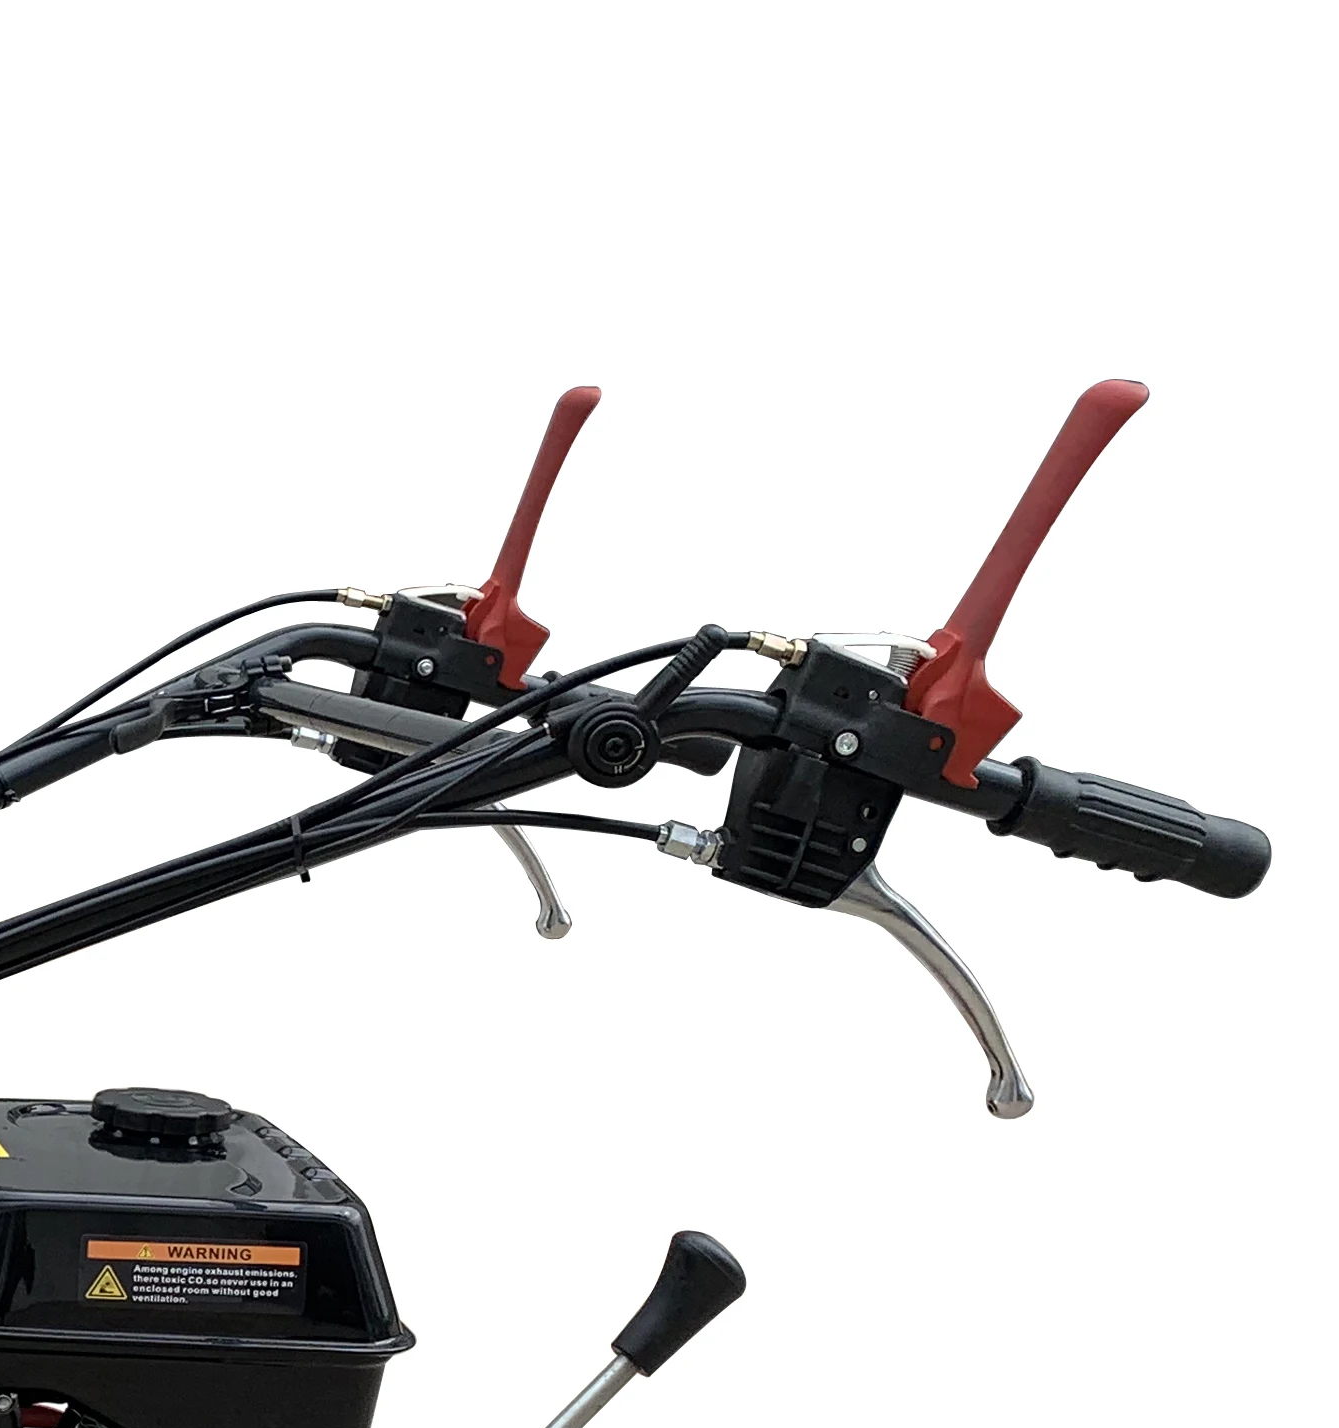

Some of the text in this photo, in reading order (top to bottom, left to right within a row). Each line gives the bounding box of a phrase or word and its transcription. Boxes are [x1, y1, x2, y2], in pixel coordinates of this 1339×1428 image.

[167, 1246, 252, 1261] WARNING
[133, 1264, 168, 1276] Among
[170, 1267, 203, 1277] engine
[205, 1267, 244, 1277] exhaust
[133, 1275, 159, 1283] there
[161, 1276, 186, 1284] toxic
[269, 1279, 279, 1288] in
[133, 1284, 279, 1298] enclosed room without good
[132, 1294, 189, 1304] ventilation.
